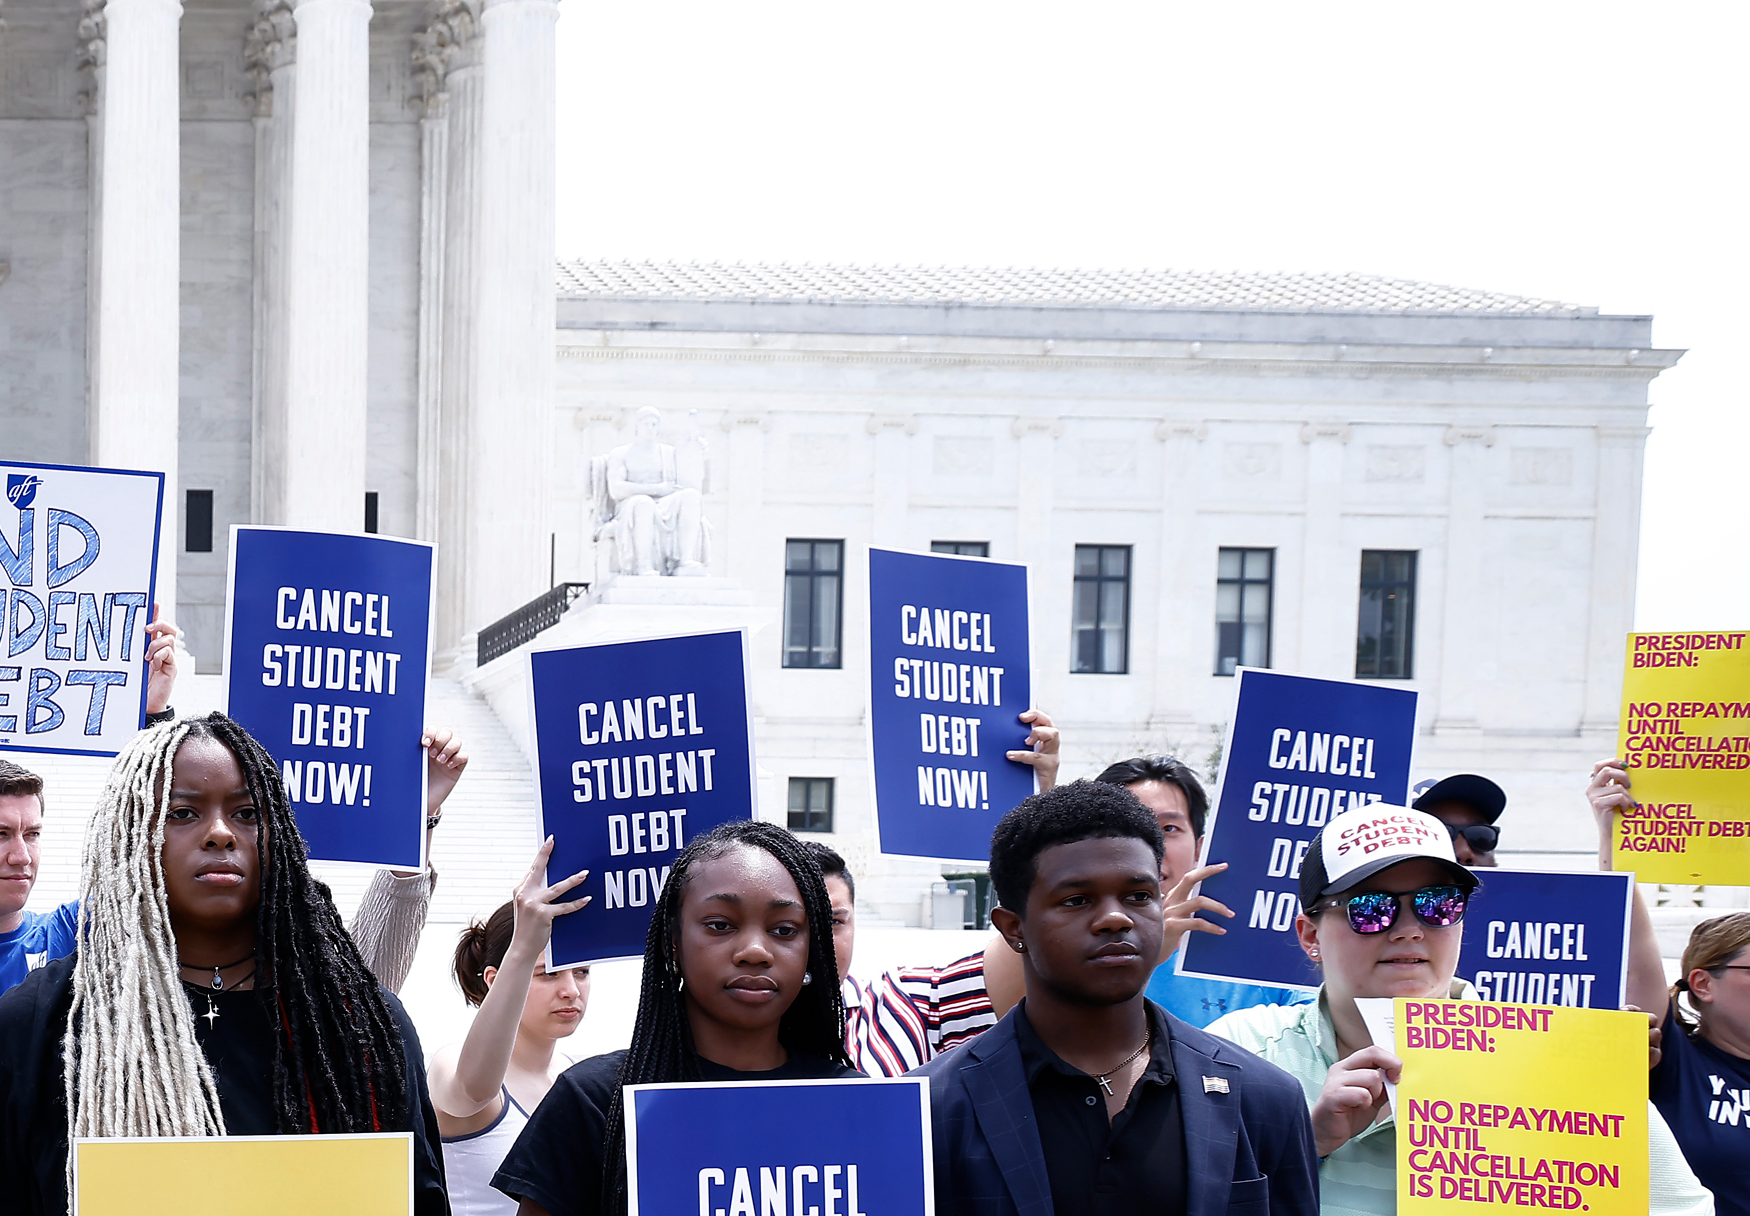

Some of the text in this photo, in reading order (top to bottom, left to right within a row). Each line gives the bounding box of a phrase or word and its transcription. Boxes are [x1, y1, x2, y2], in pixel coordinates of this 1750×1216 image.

[7, 474, 44, 505] aft
[276, 586, 393, 638] CANCEL
[901, 604, 996, 654] CANCEL
[1633, 652, 1699, 668] BIDEN:
[1634, 634, 1746, 652] PRESIDENT
[261, 643, 401, 696] STUDENT
[894, 657, 1004, 707] STUDENT
[291, 703, 370, 750] DEBT
[578, 692, 704, 746] CANCEL
[1627, 719, 1684, 735] UNTIL
[1629, 702, 1662, 718] NO
[920, 713, 981, 757] DEBT
[1268, 728, 1376, 779] CANCEL
[1625, 736, 1750, 753] CANCELLATI
[571, 748, 716, 803] STUDENT
[1624, 753, 1643, 769] IS
[283, 760, 372, 808] NOW!
[917, 765, 990, 810] NOW!
[607, 808, 687, 856] DEBT
[1337, 826, 1440, 856] STUDENT
[1340, 815, 1432, 840] CANCEL
[1363, 836, 1424, 855] DEBT
[1619, 837, 1687, 854] AGAIN!
[1620, 820, 1705, 837] STUDENT
[1249, 890, 1300, 932] NO
[1486, 920, 1588, 961] CANCEL
[1475, 971, 1597, 1009] STUDENT
[1405, 1002, 1554, 1033] PRESIDENT
[1406, 1026, 1496, 1054] BIDEN:
[1408, 1099, 1625, 1139] NO REPAYMENT
[1408, 1124, 1486, 1152] UNTIL
[1408, 1149, 1619, 1188] CANCELLATION
[1409, 1174, 1590, 1211] IS DELIVERED.
